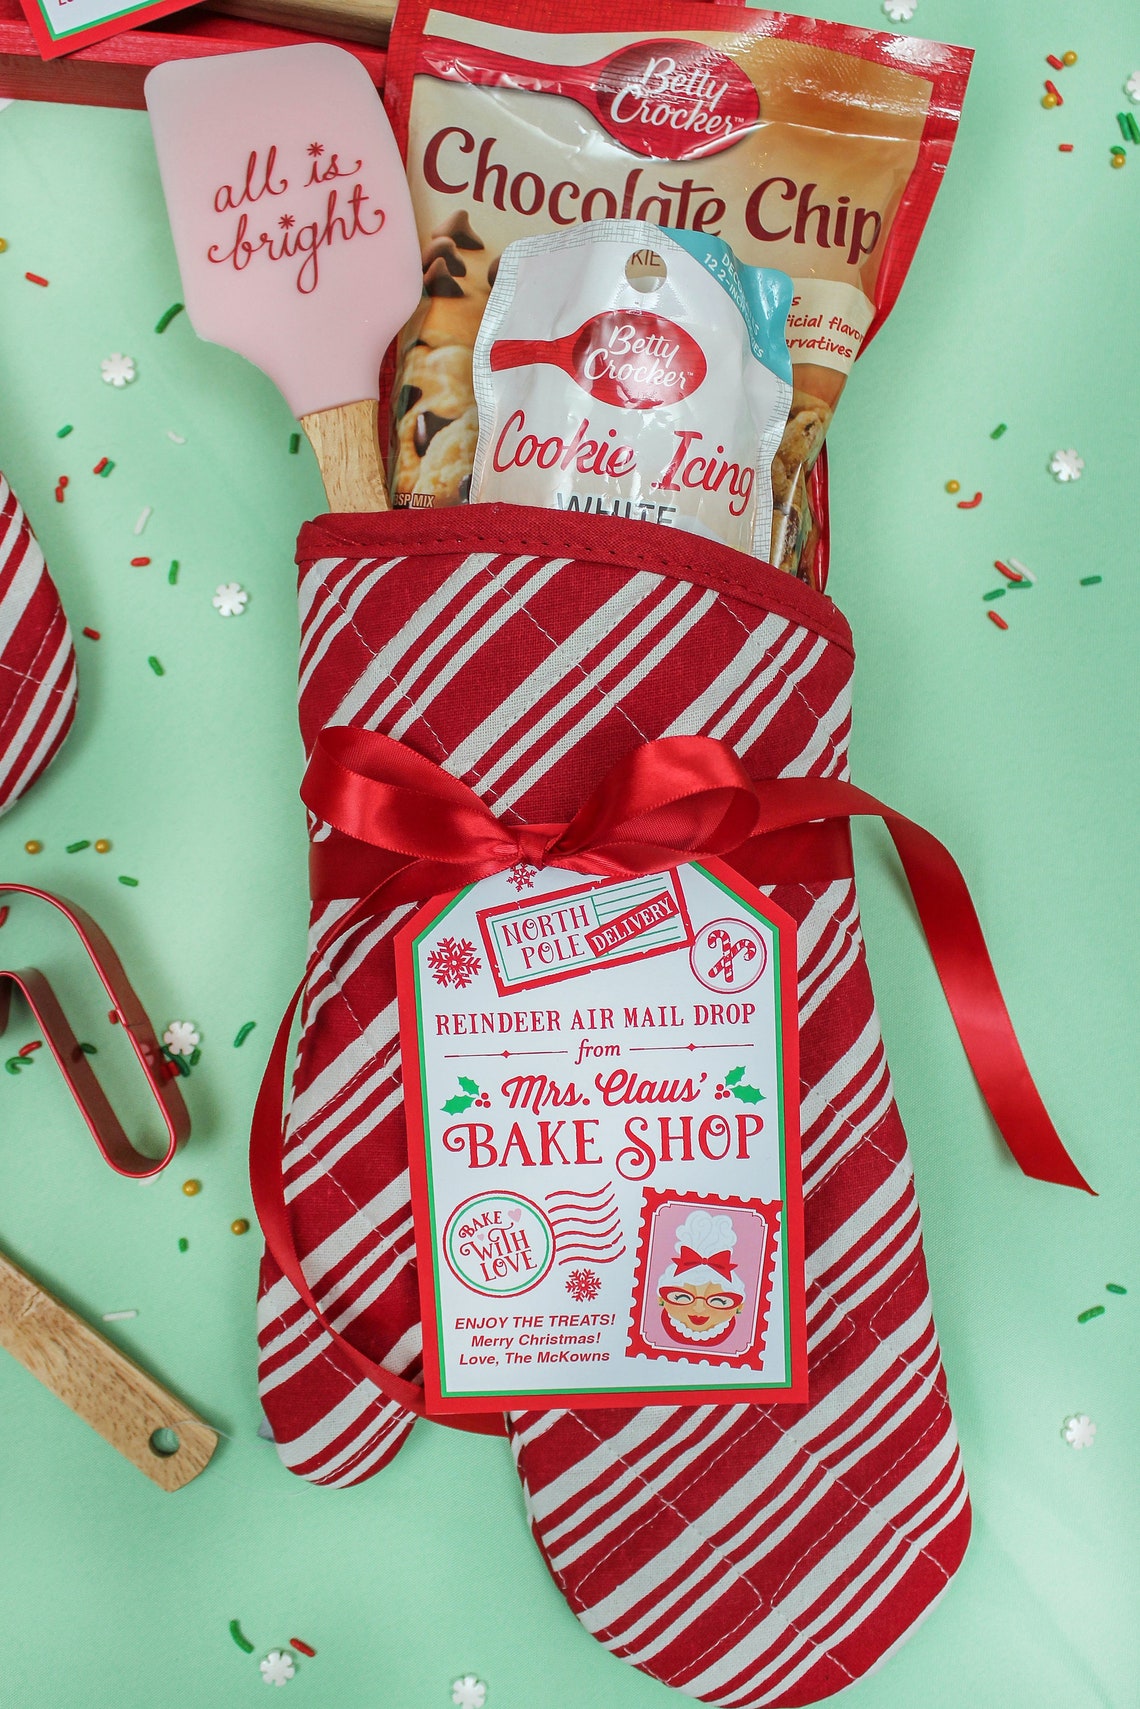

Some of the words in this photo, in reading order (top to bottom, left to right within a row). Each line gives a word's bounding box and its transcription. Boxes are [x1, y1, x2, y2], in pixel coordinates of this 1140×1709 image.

[641, 57, 729, 112] Betty
[214, 145, 288, 213] all
[304, 142, 363, 188] is
[423, 126, 726, 236] Chocolate
[745, 177, 881, 265] Chip
[207, 183, 386, 294] bright
[704, 253, 719, 271] 12
[608, 325, 680, 369] Betty
[493, 409, 638, 478] Cookie
[650, 430, 756, 517] Icing
[413, 494, 435, 508] MIX
[557, 492, 677, 524] WHITE
[500, 904, 591, 947] NORTH
[590, 896, 675, 952] DELIVERY
[521, 933, 587, 970] POLE
[435, 1009, 561, 1036] REINDEER
[570, 1007, 615, 1030] AIR
[624, 1005, 684, 1028] MAIL
[693, 1003, 756, 1026] DROP
[574, 1038, 622, 1065] from
[502, 1073, 591, 1116] Mrs.
[442, 1119, 603, 1169] BAKE
[615, 1113, 765, 1181] SHOP
[458, 1210, 503, 1239] BAKE
[459, 1222, 530, 1262] WITH
[479, 1249, 538, 1282] LOVE
[454, 1316, 509, 1330] ENJOY
[513, 1315, 545, 1328] THE
[549, 1313, 616, 1327] TREATS!
[471, 1334, 514, 1349] Merry
[518, 1332, 602, 1346] Christmas!
[459, 1353, 500, 1367] Love,
[505, 1352, 535, 1364] The
[537, 1350, 611, 1363] McKowns
